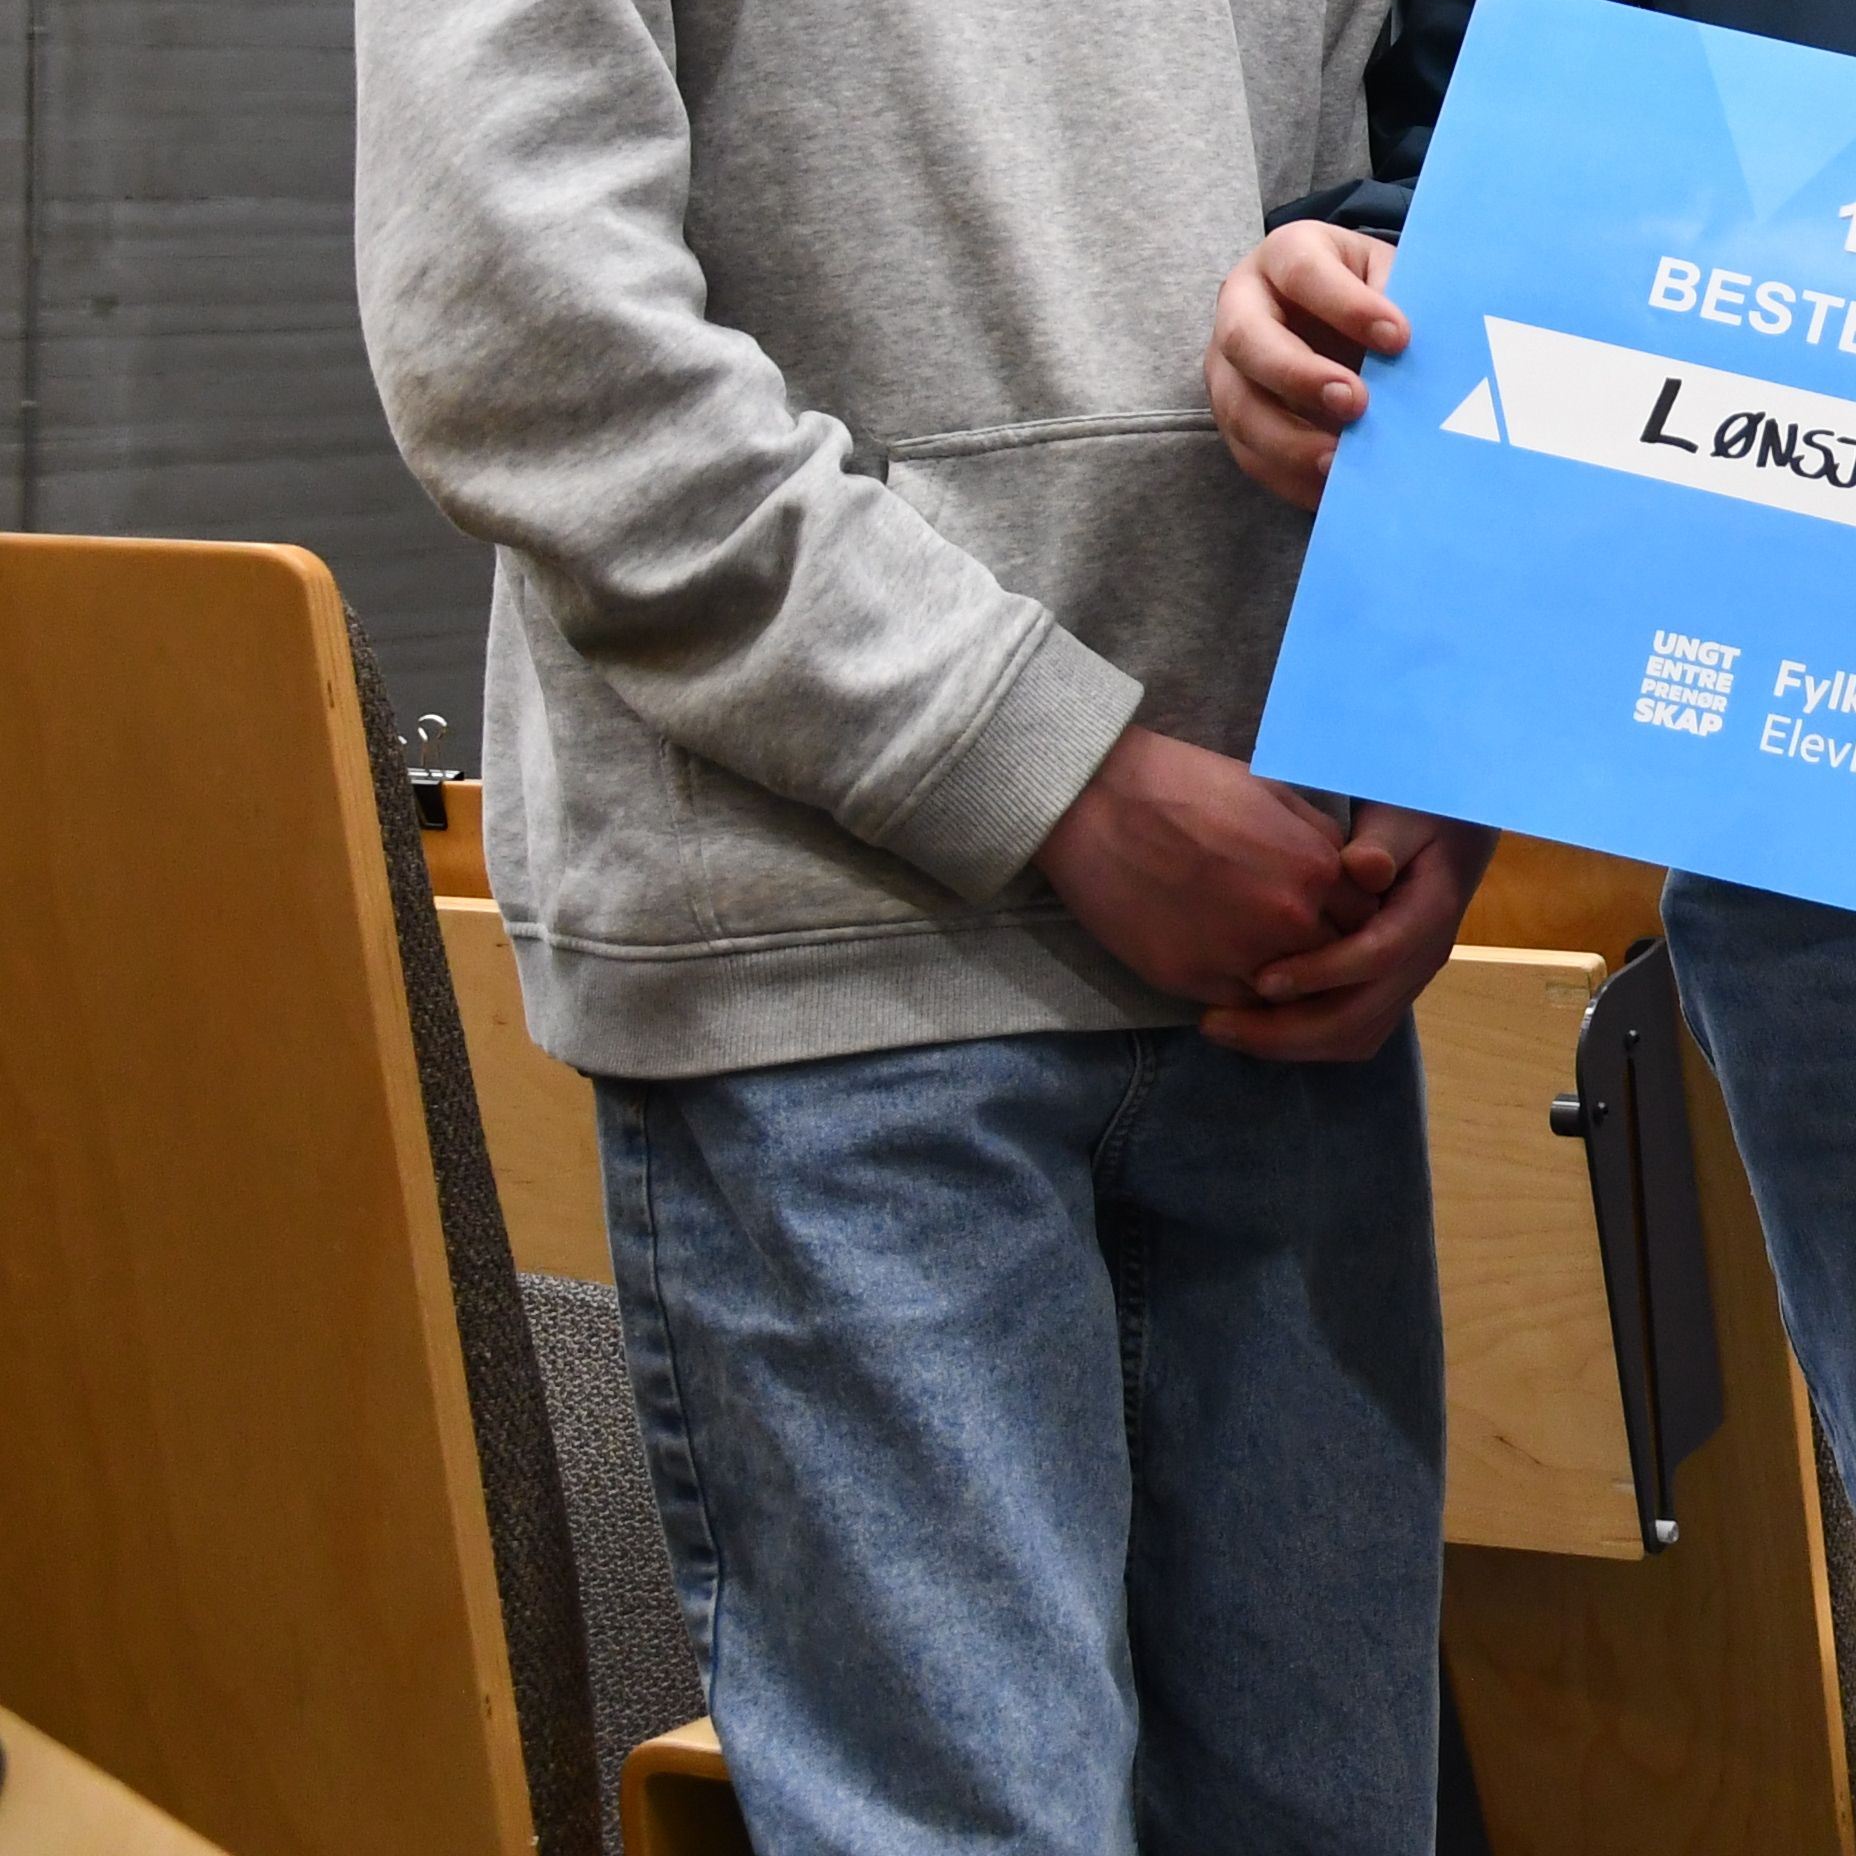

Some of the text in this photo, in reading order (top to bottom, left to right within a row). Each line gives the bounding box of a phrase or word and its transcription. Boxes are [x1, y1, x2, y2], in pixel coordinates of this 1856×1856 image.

[1653, 630, 1741, 670] UNGT
[1646, 655, 1734, 693] ENTRE
[1641, 678, 1728, 712] PRENØR
[1633, 697, 1723, 736] SKAP
